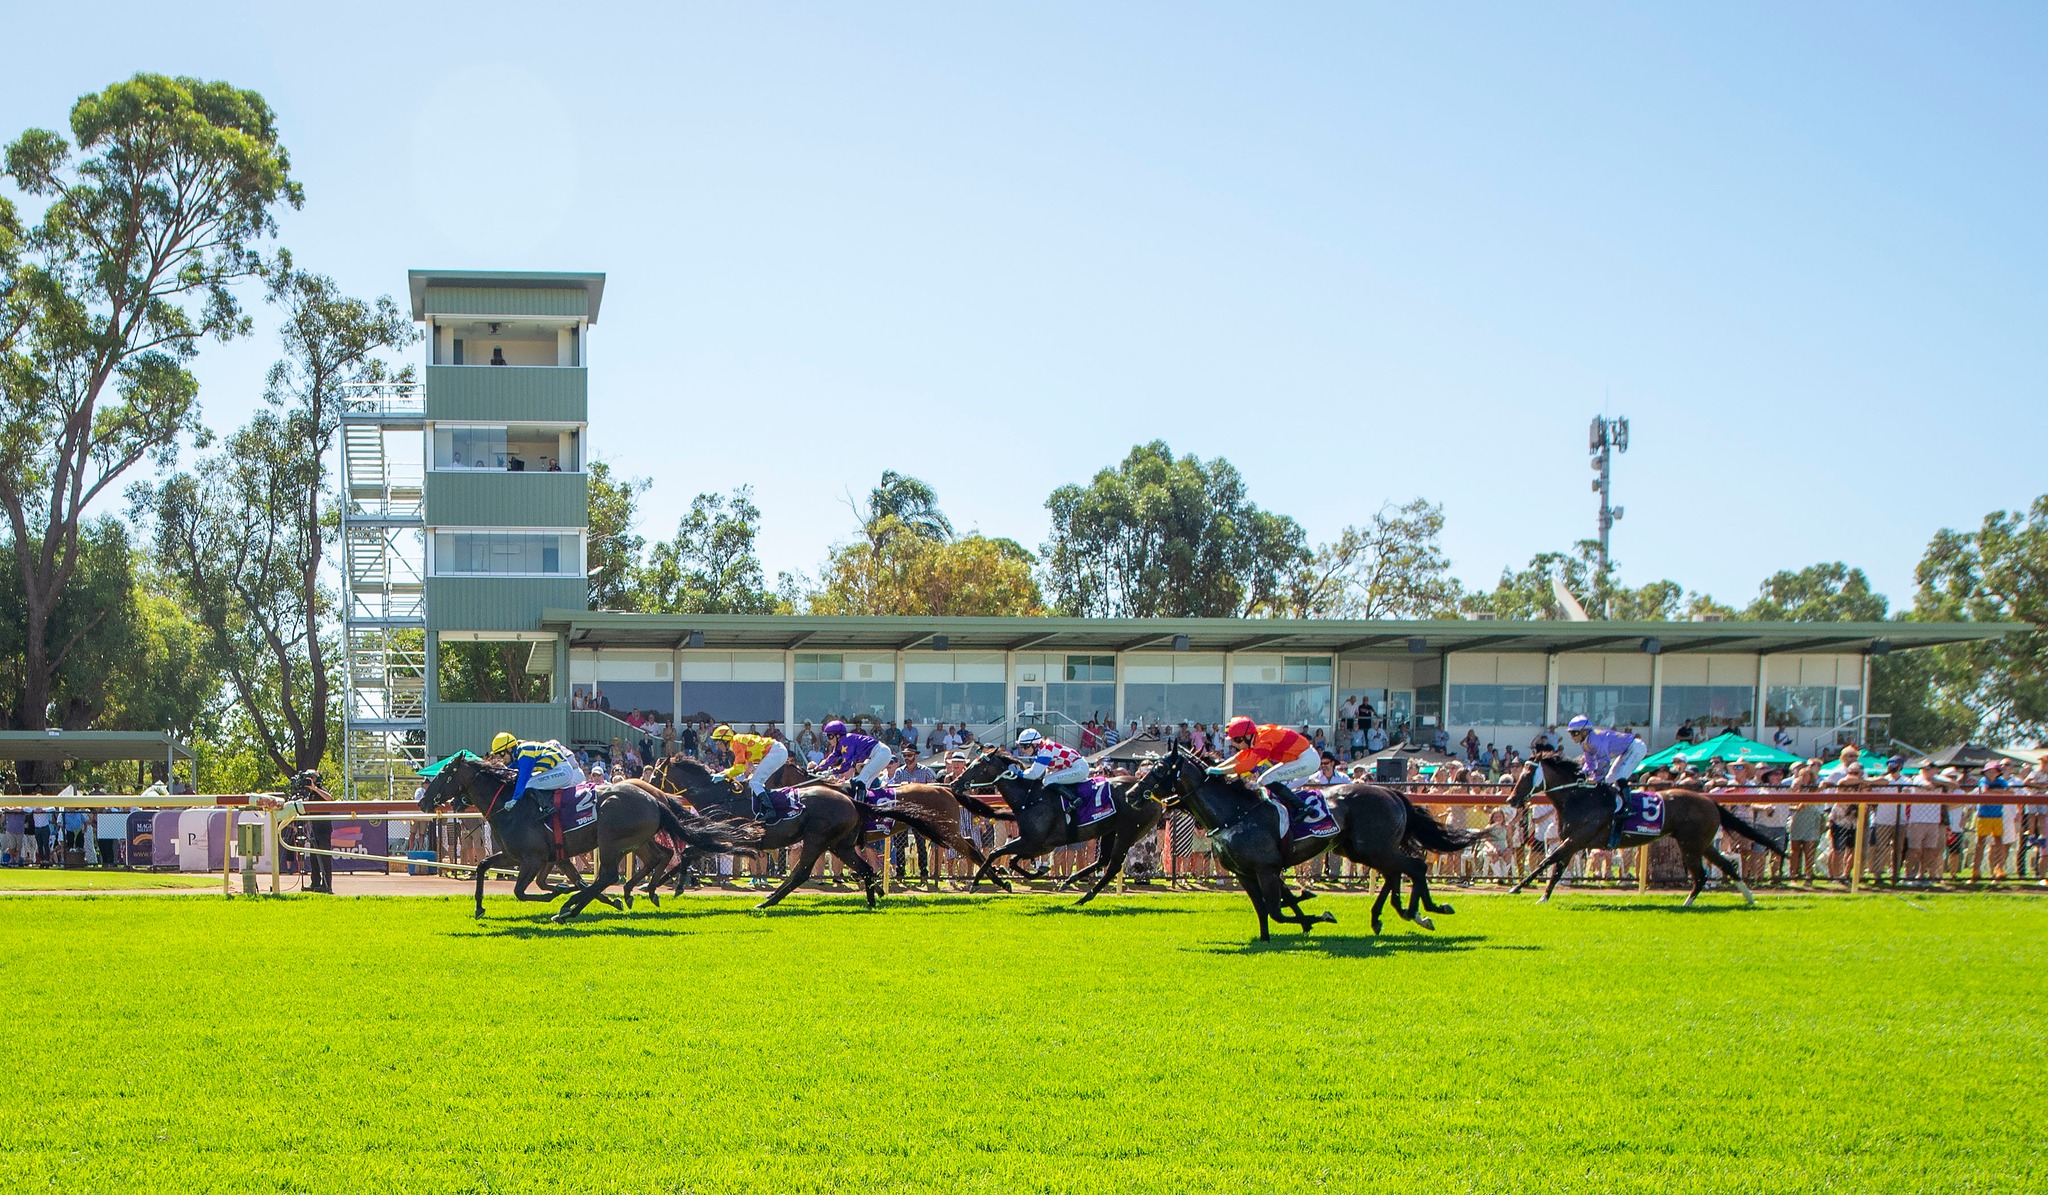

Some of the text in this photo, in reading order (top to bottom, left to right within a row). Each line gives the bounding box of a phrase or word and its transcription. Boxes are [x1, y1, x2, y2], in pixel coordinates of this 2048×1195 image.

[575, 788, 595, 812] 2
[1092, 782, 1106, 807] 7
[1304, 795, 1327, 823] 3
[1641, 796, 1660, 821] 5
